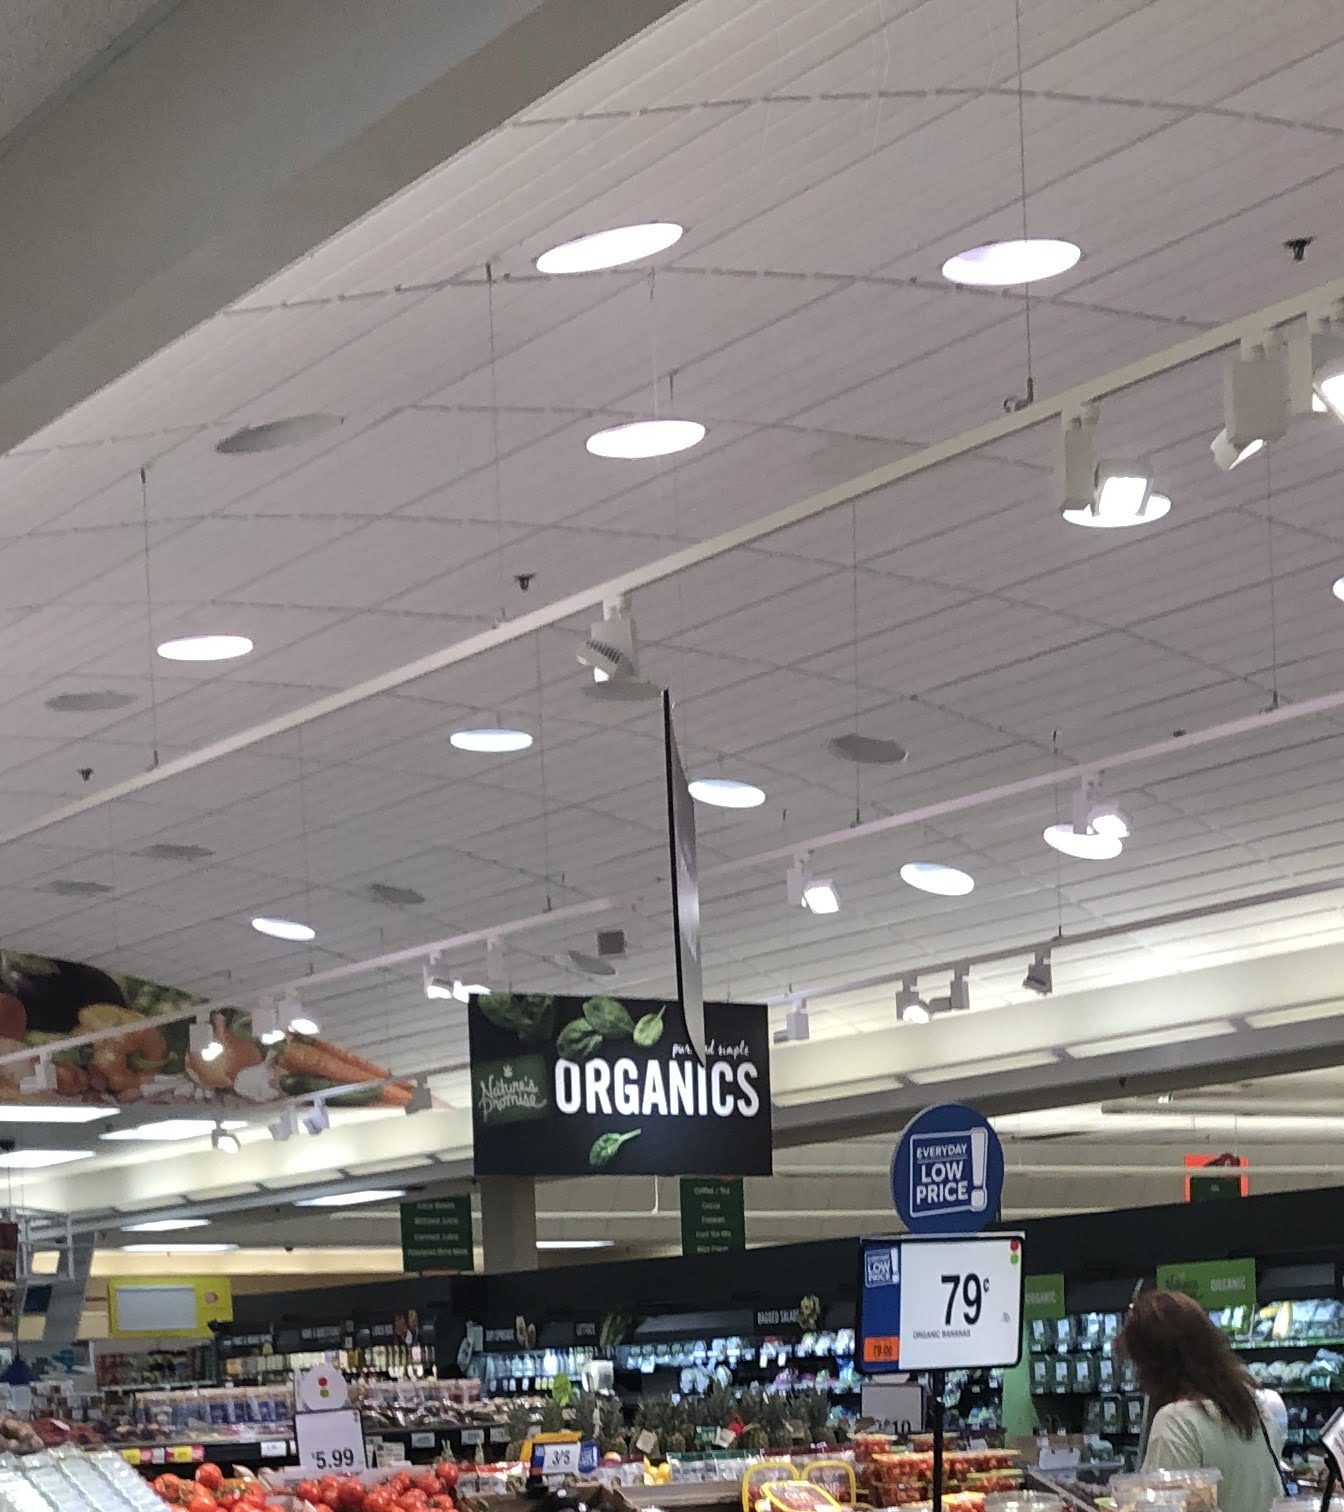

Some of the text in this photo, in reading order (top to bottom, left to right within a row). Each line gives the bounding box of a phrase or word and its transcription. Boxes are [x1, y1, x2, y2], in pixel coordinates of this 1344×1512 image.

[671, 1042, 693, 1059] pur
[480, 1073, 538, 1100] Nature's
[555, 1057, 760, 1118] ORGANICS
[916, 1142, 967, 1160] EVERYDAY
[921, 1161, 964, 1184] LOW
[916, 1180, 969, 1205] PRICE
